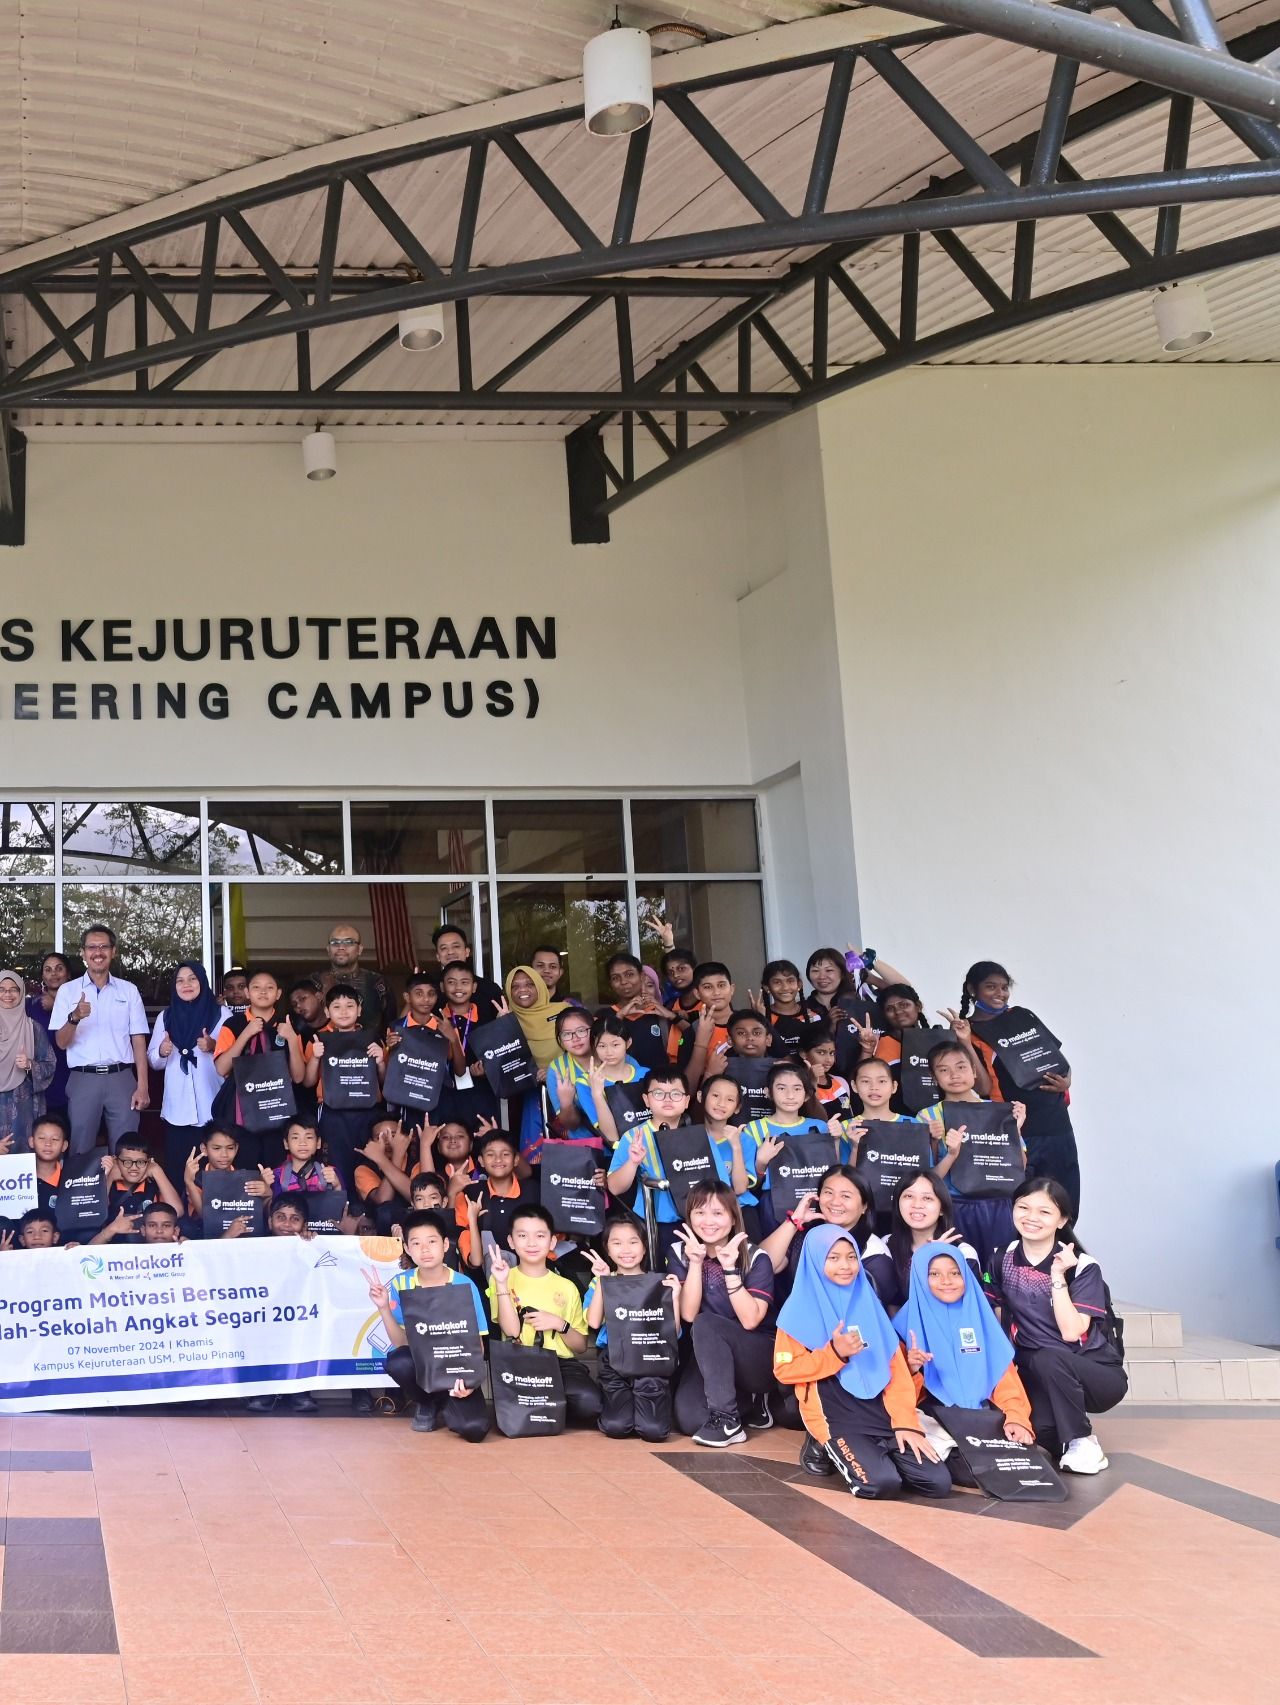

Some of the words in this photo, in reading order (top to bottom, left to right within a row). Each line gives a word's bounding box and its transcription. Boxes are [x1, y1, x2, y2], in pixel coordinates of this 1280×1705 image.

[61, 616, 557, 663] KEJURUTERAAN
[267, 678, 540, 720] CAMPUS)
[1008, 1028, 1037, 1043] malakoff
[494, 1038, 520, 1055] malakoff
[407, 1057, 439, 1069] malakoff
[255, 1078, 284, 1089] malakoff
[971, 1133, 1009, 1142] malakoff
[880, 1153, 920, 1163] malakoff
[222, 1199, 254, 1207] malakoff
[107, 1253, 184, 1272] malakoff
[89, 1288, 176, 1309] Motivasi
[182, 1285, 270, 1304] Bersama
[124, 1312, 199, 1335] Angkat
[205, 1306, 267, 1329] Segari
[272, 1303, 319, 1324] 2024
[628, 1308, 664, 1317] malakoff
[428, 1320, 468, 1331] malakoff
[67, 1347, 80, 1356] 07
[83, 1343, 136, 1355] November
[138, 1341, 165, 1351] 2024
[176, 1337, 214, 1348] Khamis
[33, 1361, 75, 1373] Kampus
[78, 1356, 146, 1370] Kejuruteraan
[178, 1352, 208, 1362] Pulau
[211, 1349, 246, 1361] Pinang
[515, 1375, 552, 1384] malakoff
